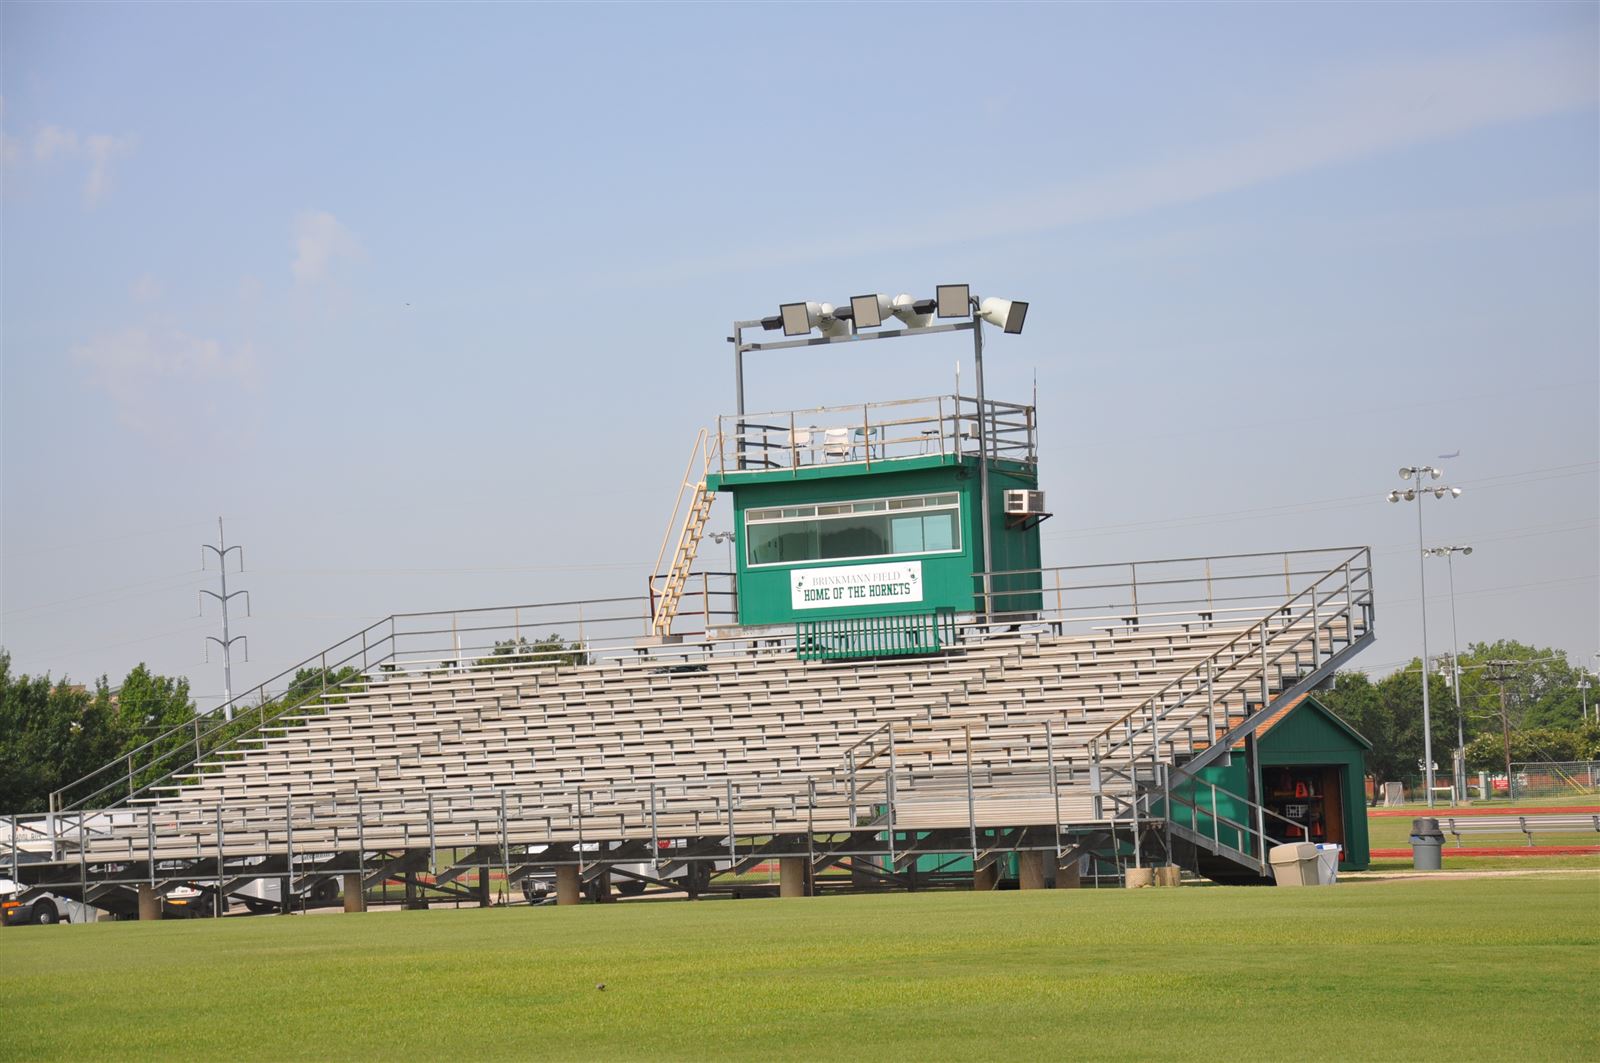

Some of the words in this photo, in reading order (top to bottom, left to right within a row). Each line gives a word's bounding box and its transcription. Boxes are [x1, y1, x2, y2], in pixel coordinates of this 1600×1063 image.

[812, 573, 871, 586] BRINKMANN
[873, 571, 901, 582] FIELD
[804, 588, 830, 601] HOME
[833, 587, 844, 600] OF
[847, 585, 866, 598] THE
[869, 582, 911, 597] HORNETS
